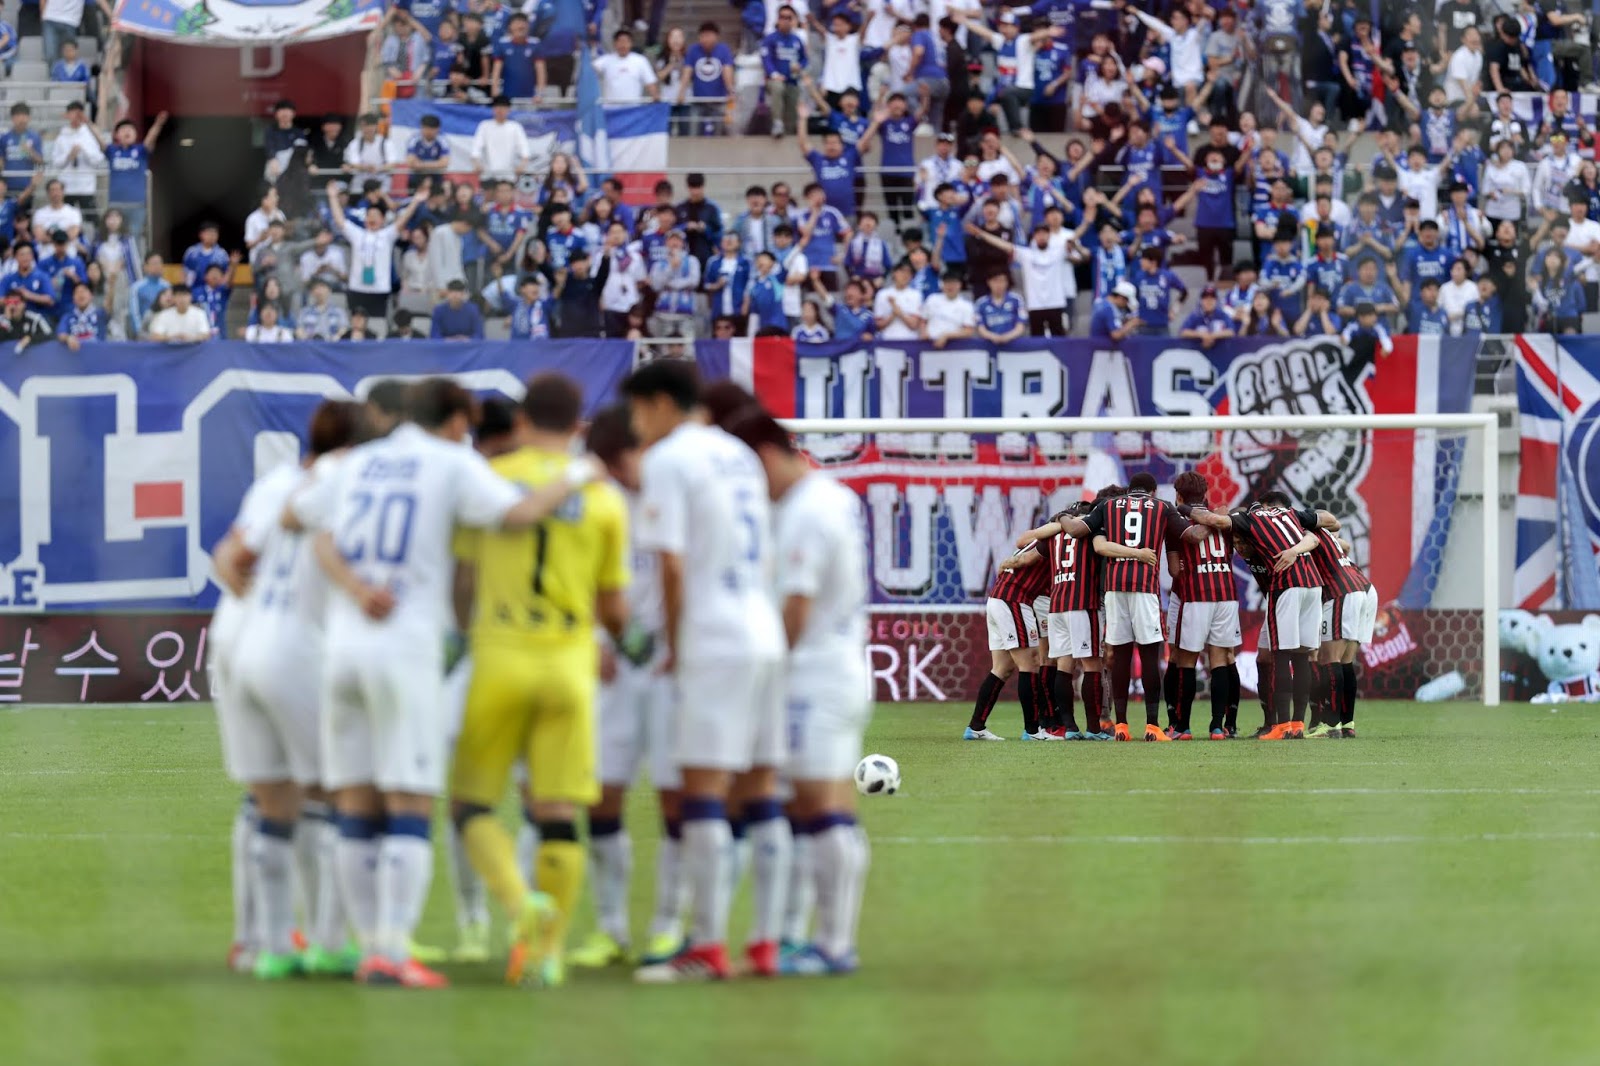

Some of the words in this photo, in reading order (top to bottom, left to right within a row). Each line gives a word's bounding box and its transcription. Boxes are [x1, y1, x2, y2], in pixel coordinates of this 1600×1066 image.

[797, 347, 1218, 464] ULTRAS
[337, 490, 418, 564] 20
[1054, 533, 1077, 570] 13
[1124, 511, 1143, 548] 9
[1271, 514, 1304, 545] 11
[55, 630, 120, 701] 수
[141, 627, 212, 701] 있
